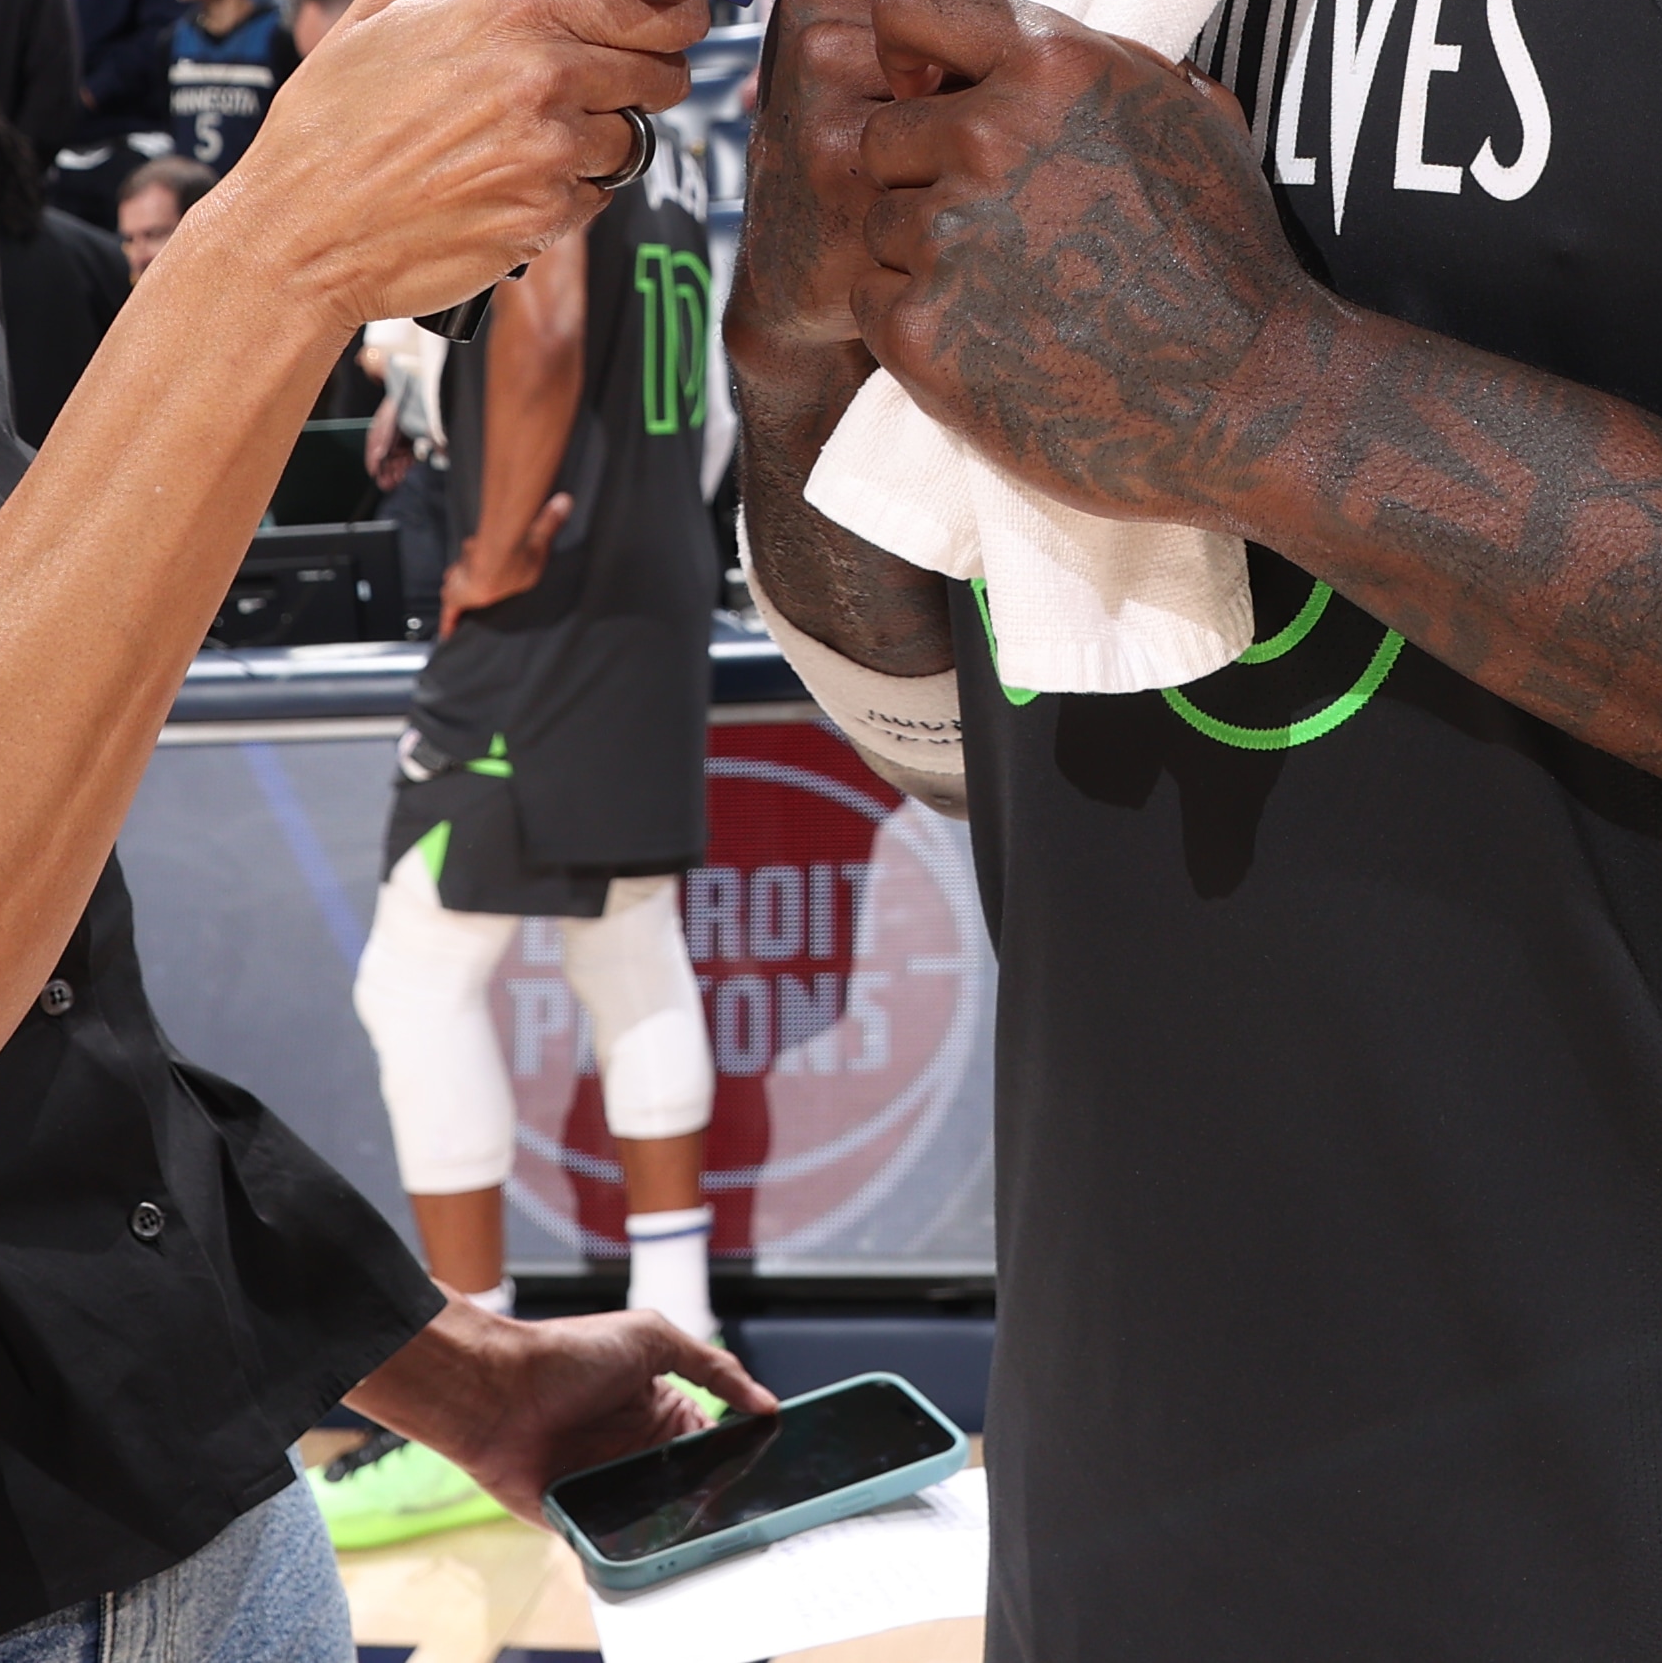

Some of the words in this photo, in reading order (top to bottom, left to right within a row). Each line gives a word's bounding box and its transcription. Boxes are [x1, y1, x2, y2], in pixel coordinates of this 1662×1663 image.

[193, 112, 225, 164] 5
[521, 862, 890, 970] ROIT
[504, 970, 893, 1079] PIONS
